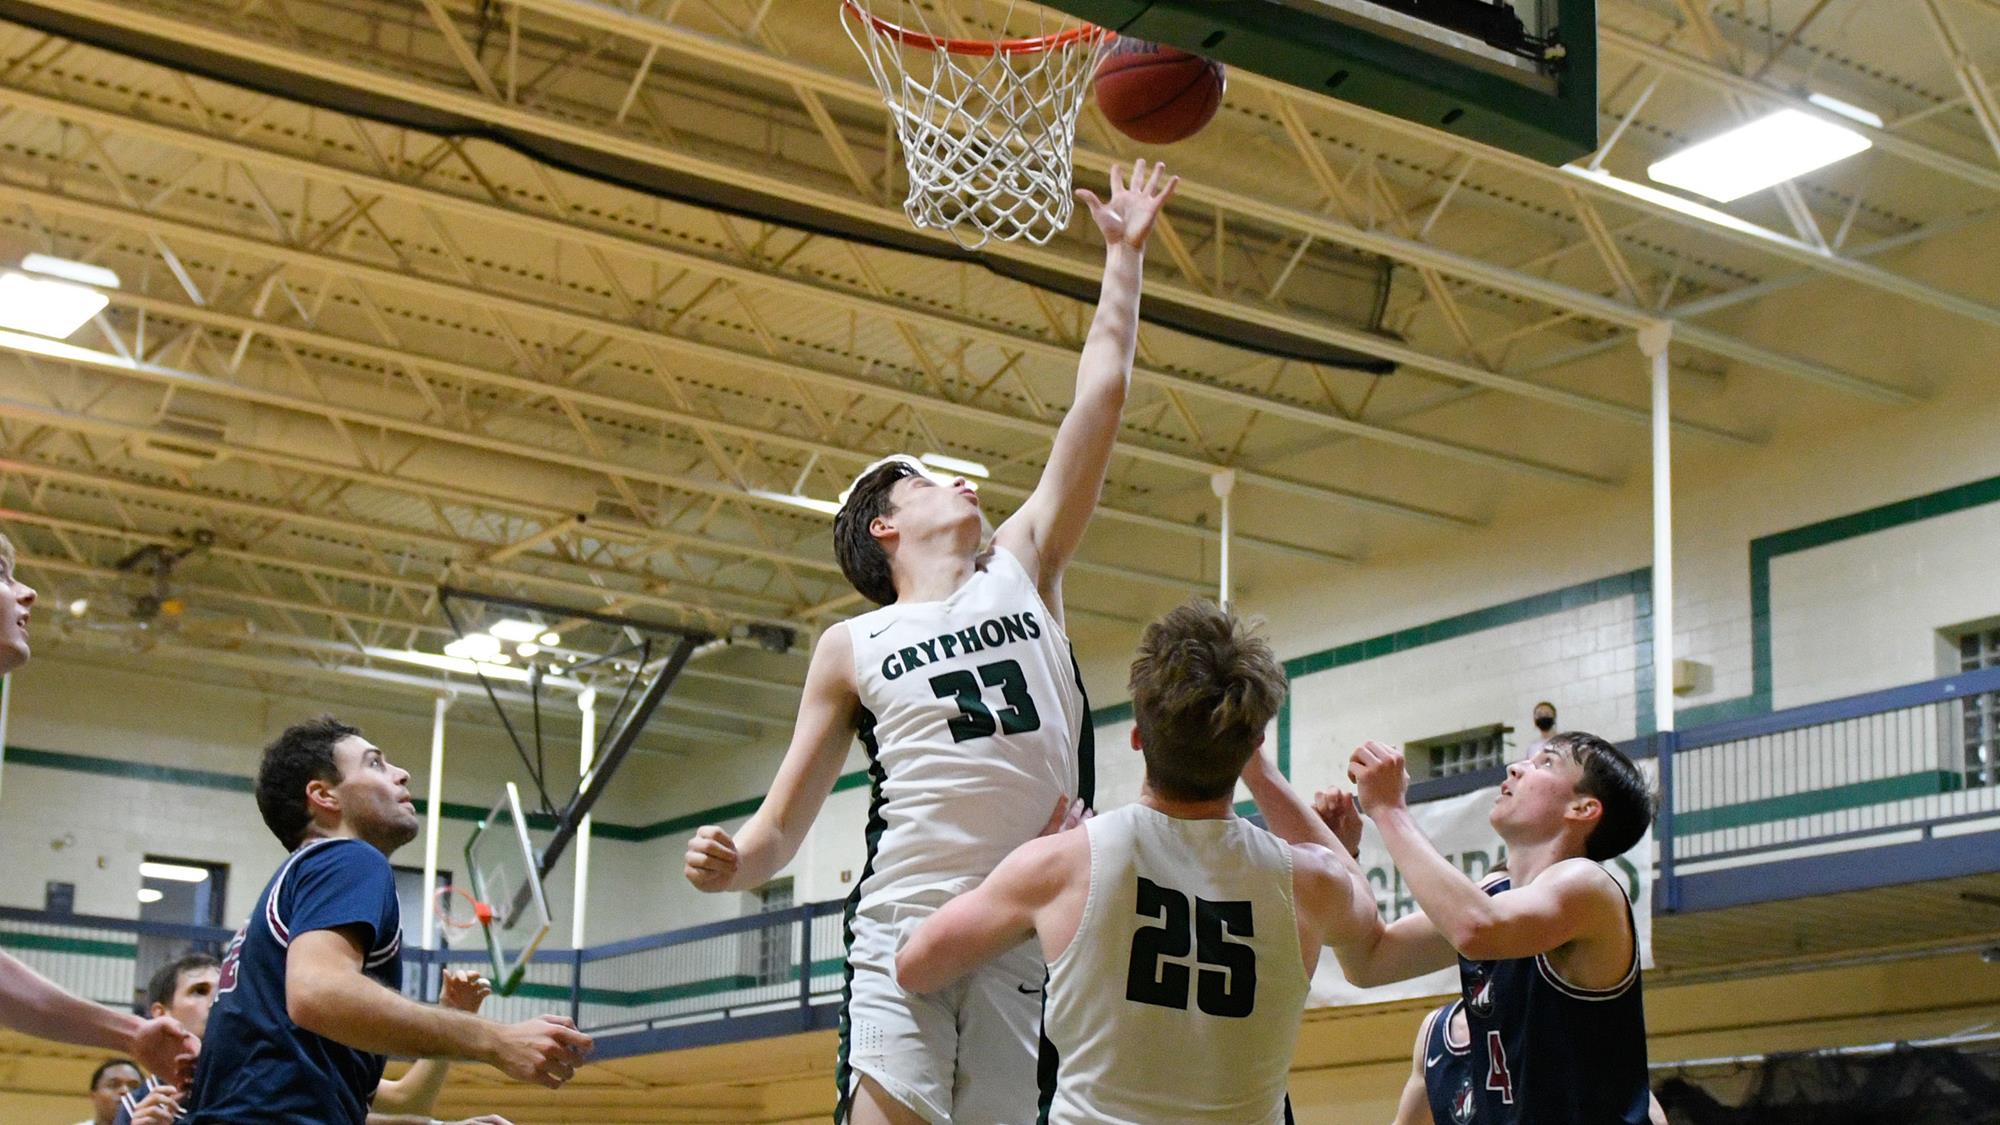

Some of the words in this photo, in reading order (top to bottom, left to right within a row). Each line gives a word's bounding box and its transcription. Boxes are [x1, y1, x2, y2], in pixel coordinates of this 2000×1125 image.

[881, 611, 1041, 681] GRYPHONS
[928, 659, 1041, 744] 33
[1126, 876, 1257, 1018] 25
[1486, 1030, 1513, 1104] 4
